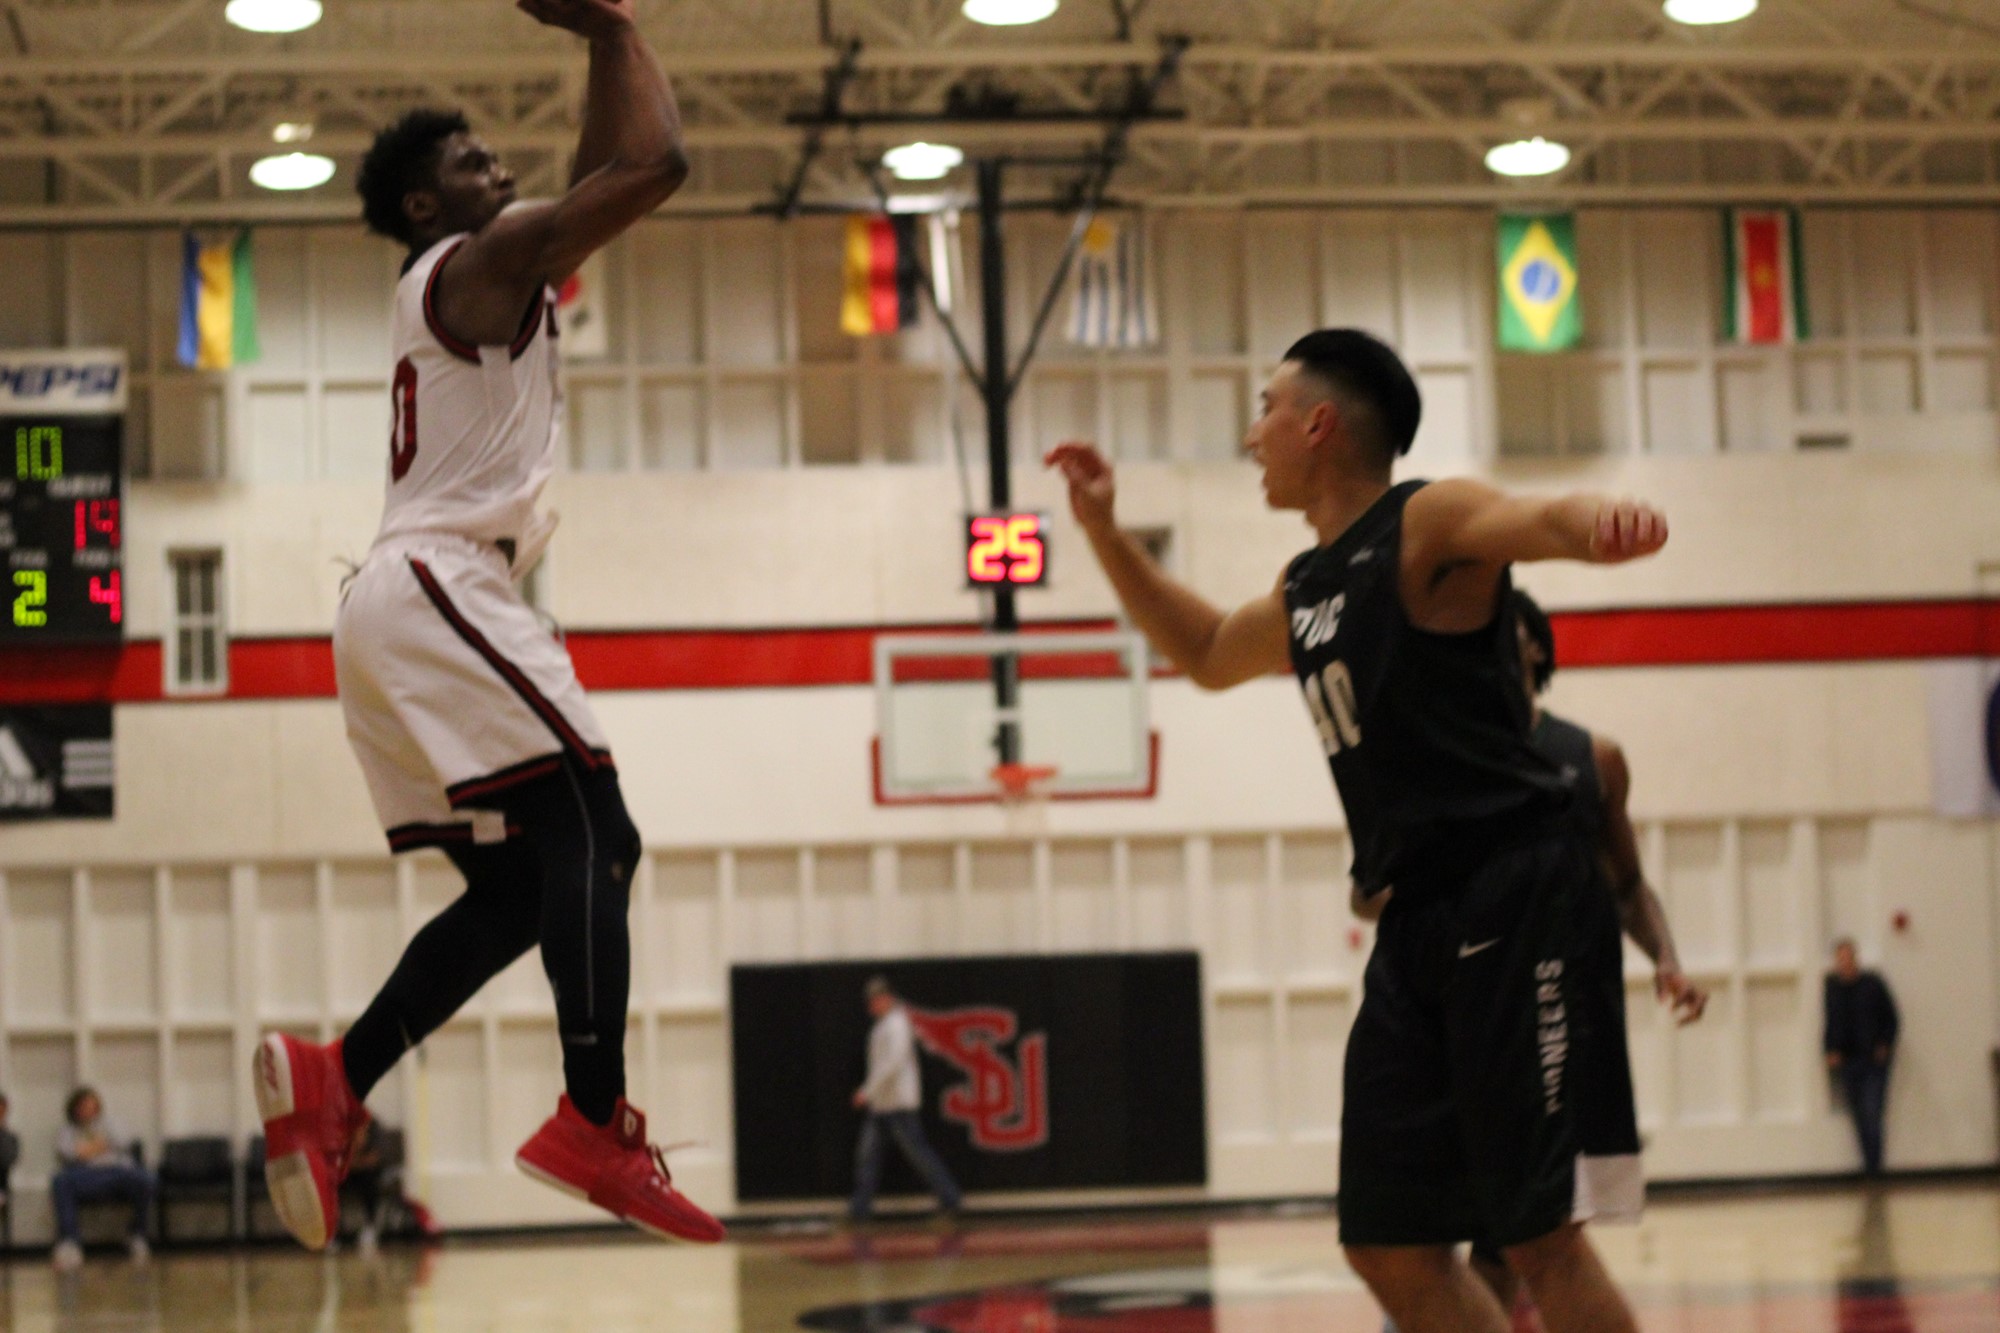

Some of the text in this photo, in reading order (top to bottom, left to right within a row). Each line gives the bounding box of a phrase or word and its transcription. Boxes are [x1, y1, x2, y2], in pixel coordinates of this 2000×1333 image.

[16, 427, 62, 480] 10
[968, 514, 1044, 583] 25
[13, 570, 47, 627] 2
[90, 570, 121, 624] 4
[1534, 958, 1569, 1117] PIONEERS
[908, 1005, 1049, 1150] SU
